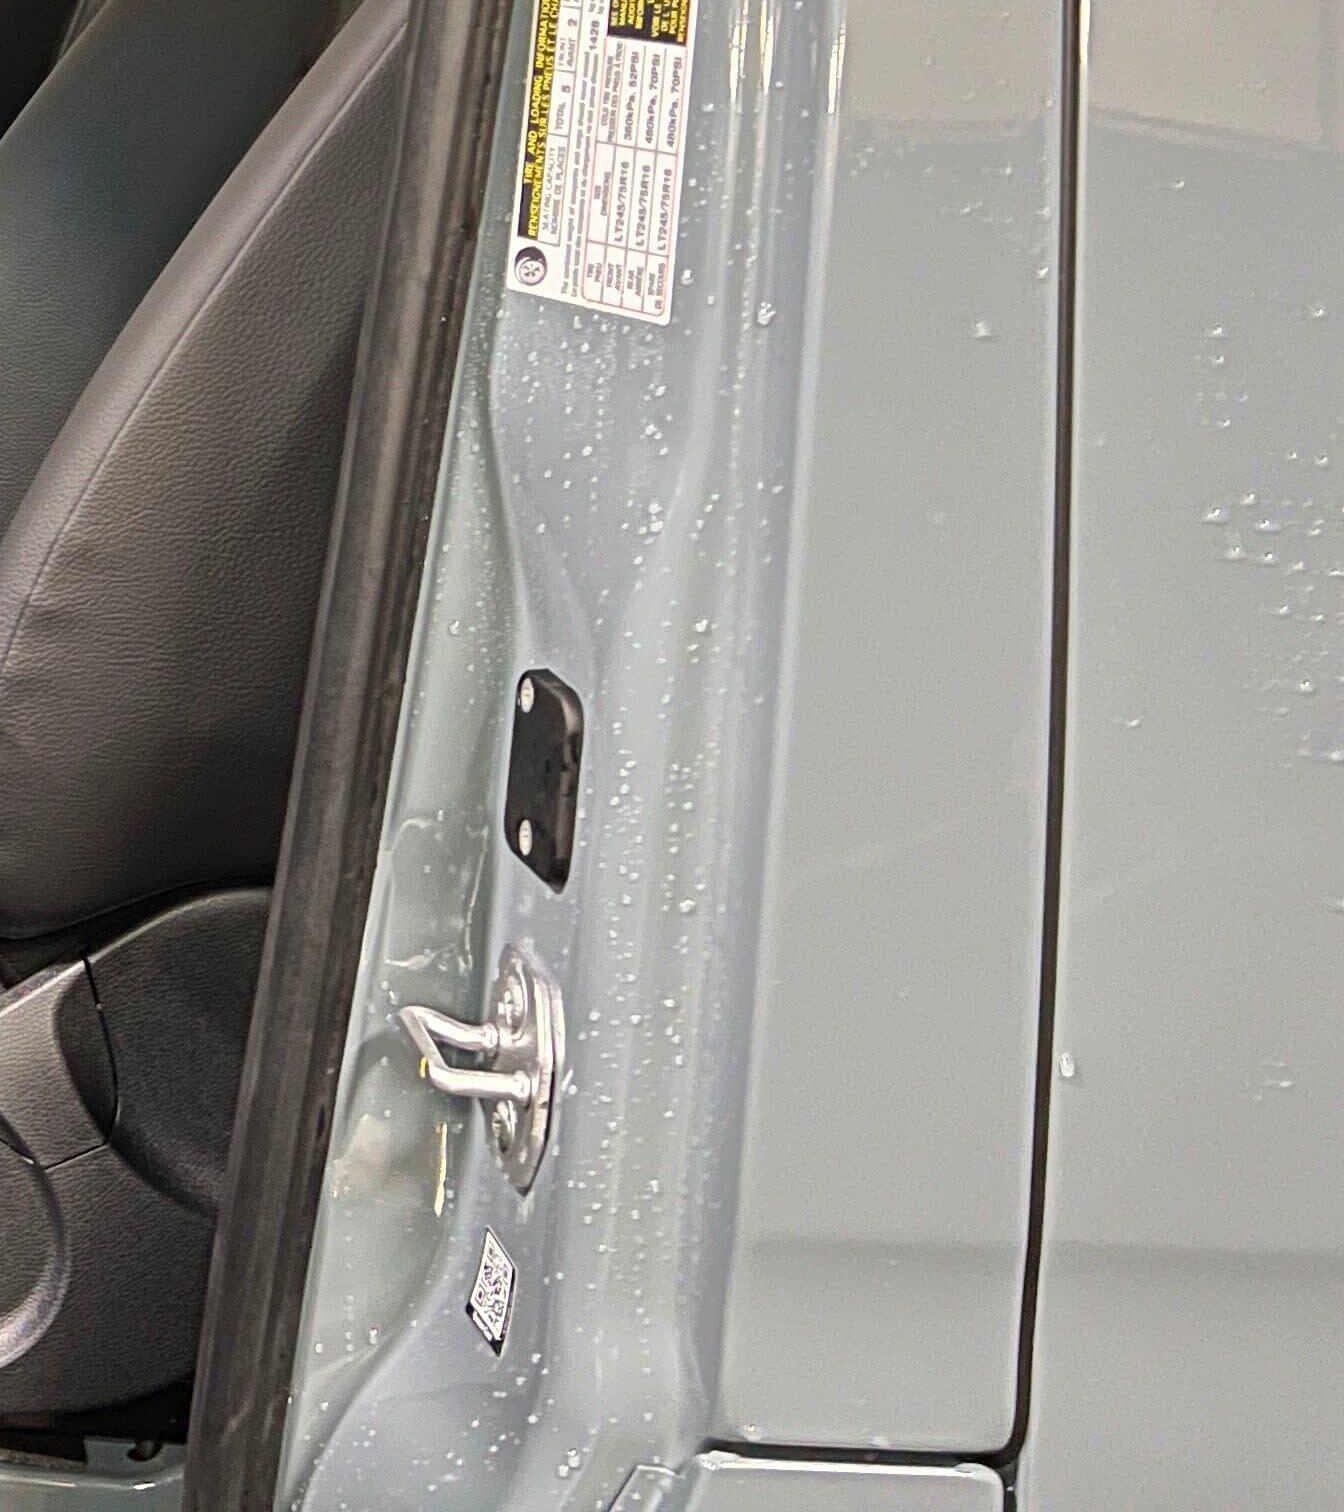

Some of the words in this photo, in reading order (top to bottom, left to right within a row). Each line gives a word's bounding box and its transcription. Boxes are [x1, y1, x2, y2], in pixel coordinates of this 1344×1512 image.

[548, 23, 557, 34] LE
[546, 39, 555, 52] ET
[543, 55, 554, 91] PNEUS
[530, 74, 543, 124] LOADING
[540, 94, 550, 114] LES
[538, 117, 548, 138] SUR
[555, 102, 566, 131] TOTAL
[527, 130, 537, 155] AND
[524, 161, 534, 185] TIRE
[546, 147, 556, 190] CAPACITY
[528, 141, 545, 237] RENSEIGNEMENTS
